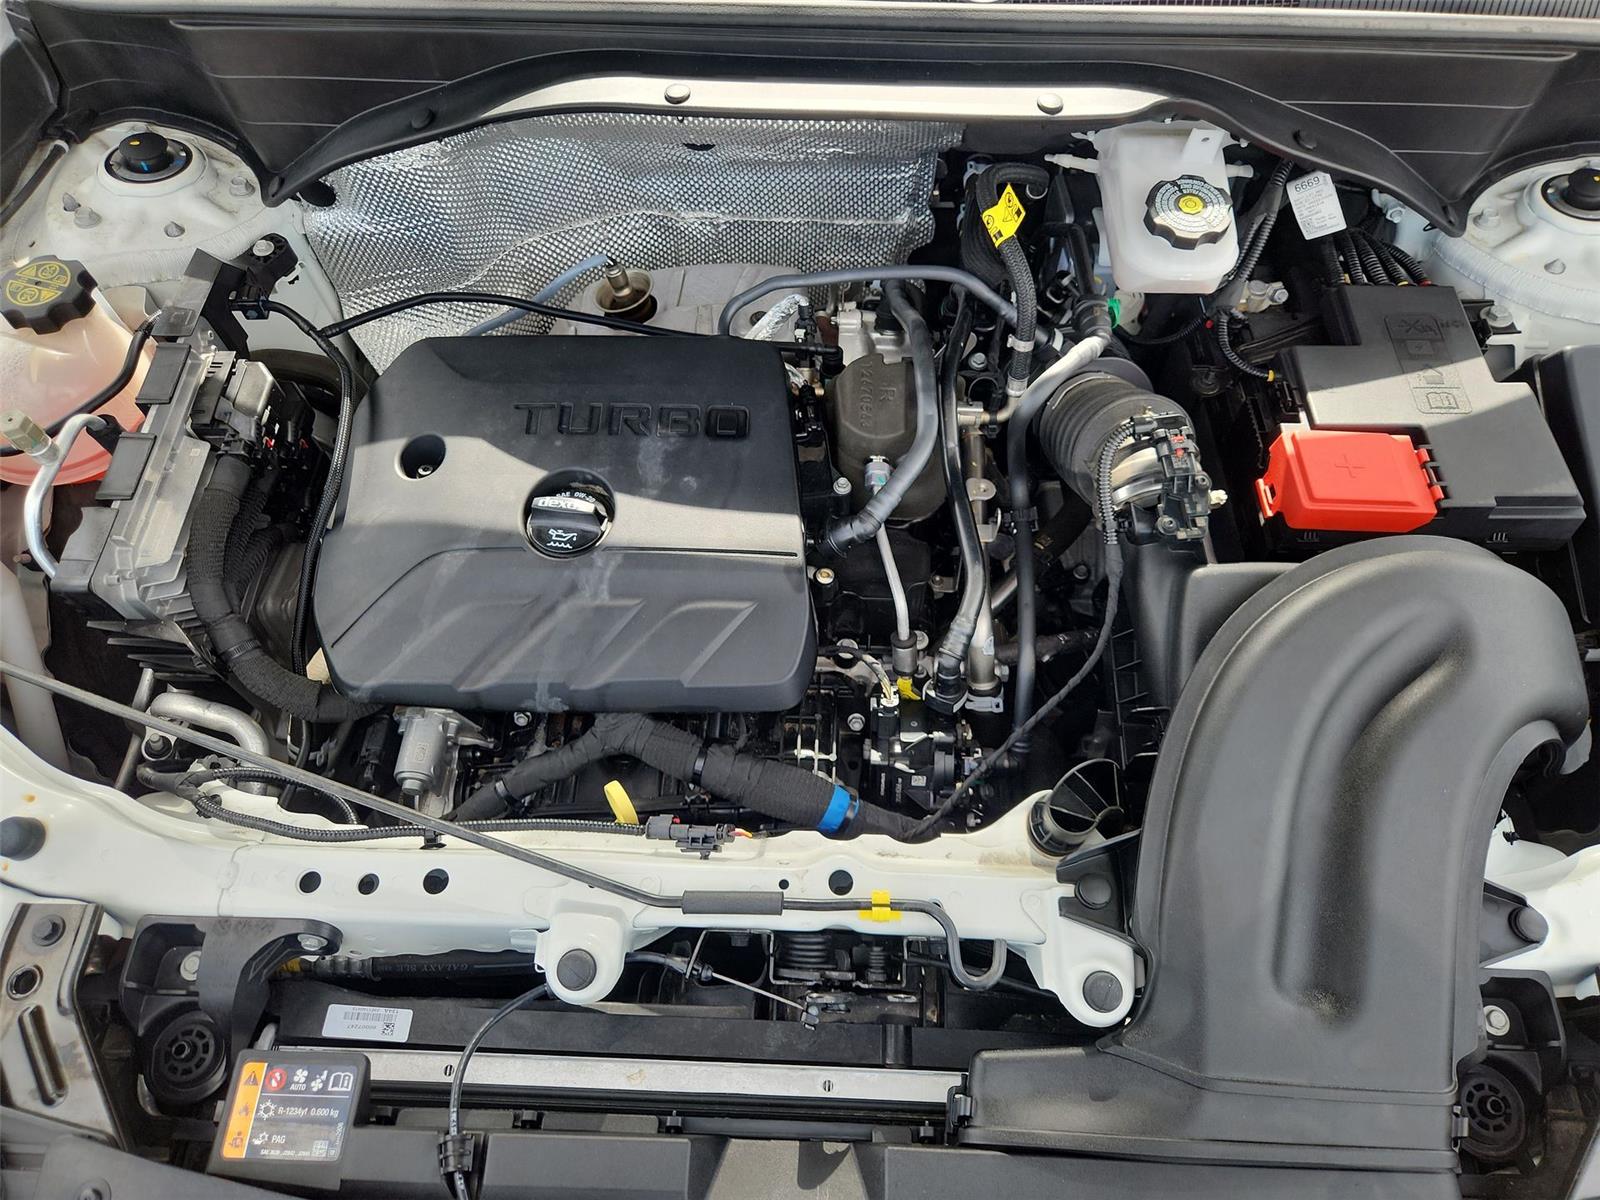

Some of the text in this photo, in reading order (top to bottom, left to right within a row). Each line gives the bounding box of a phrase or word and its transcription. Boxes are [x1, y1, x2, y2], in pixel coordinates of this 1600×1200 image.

[1294, 176, 1320, 193] 6669
[513, 402, 749, 439] TURBO
[289, 1083, 306, 1091] AUTO
[277, 1106, 340, 1119] R-1234yf 0.600 kg
[271, 1135, 286, 1144] PAG
